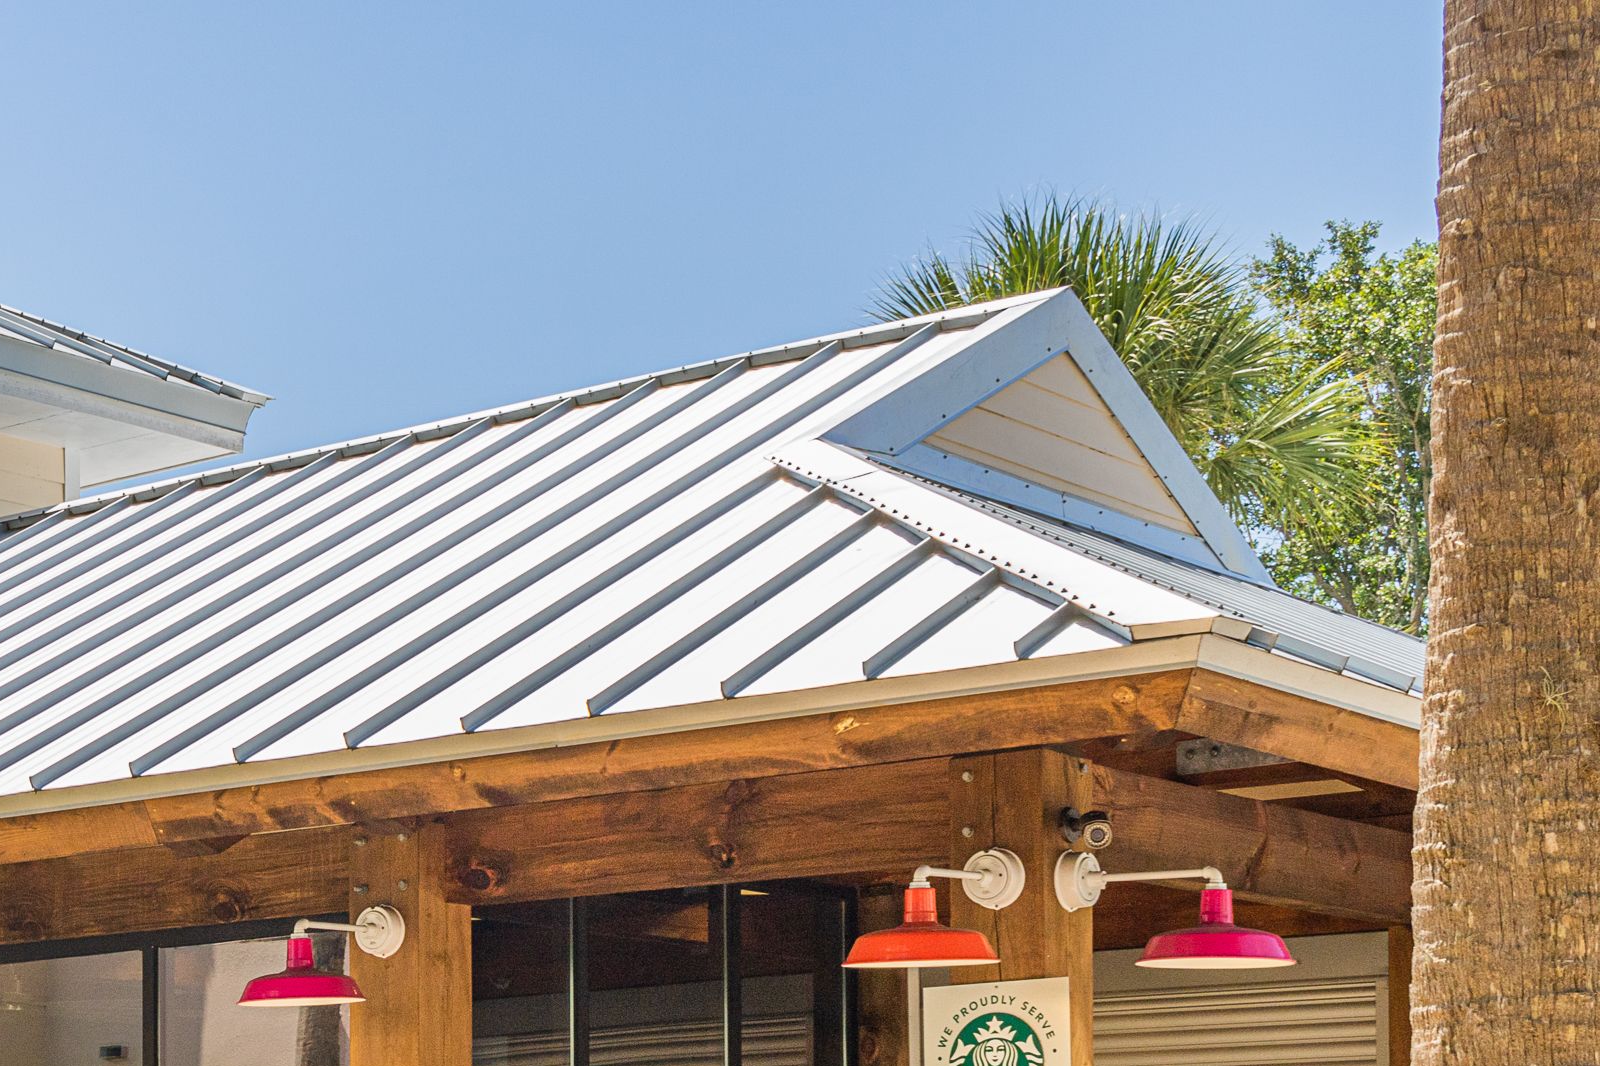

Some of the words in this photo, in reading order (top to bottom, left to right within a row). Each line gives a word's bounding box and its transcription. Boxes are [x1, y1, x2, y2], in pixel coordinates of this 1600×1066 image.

[938, 1027, 953, 1048] WE
[953, 995, 1016, 1023] PROUDLY
[1021, 1001, 1055, 1039] SERVE
